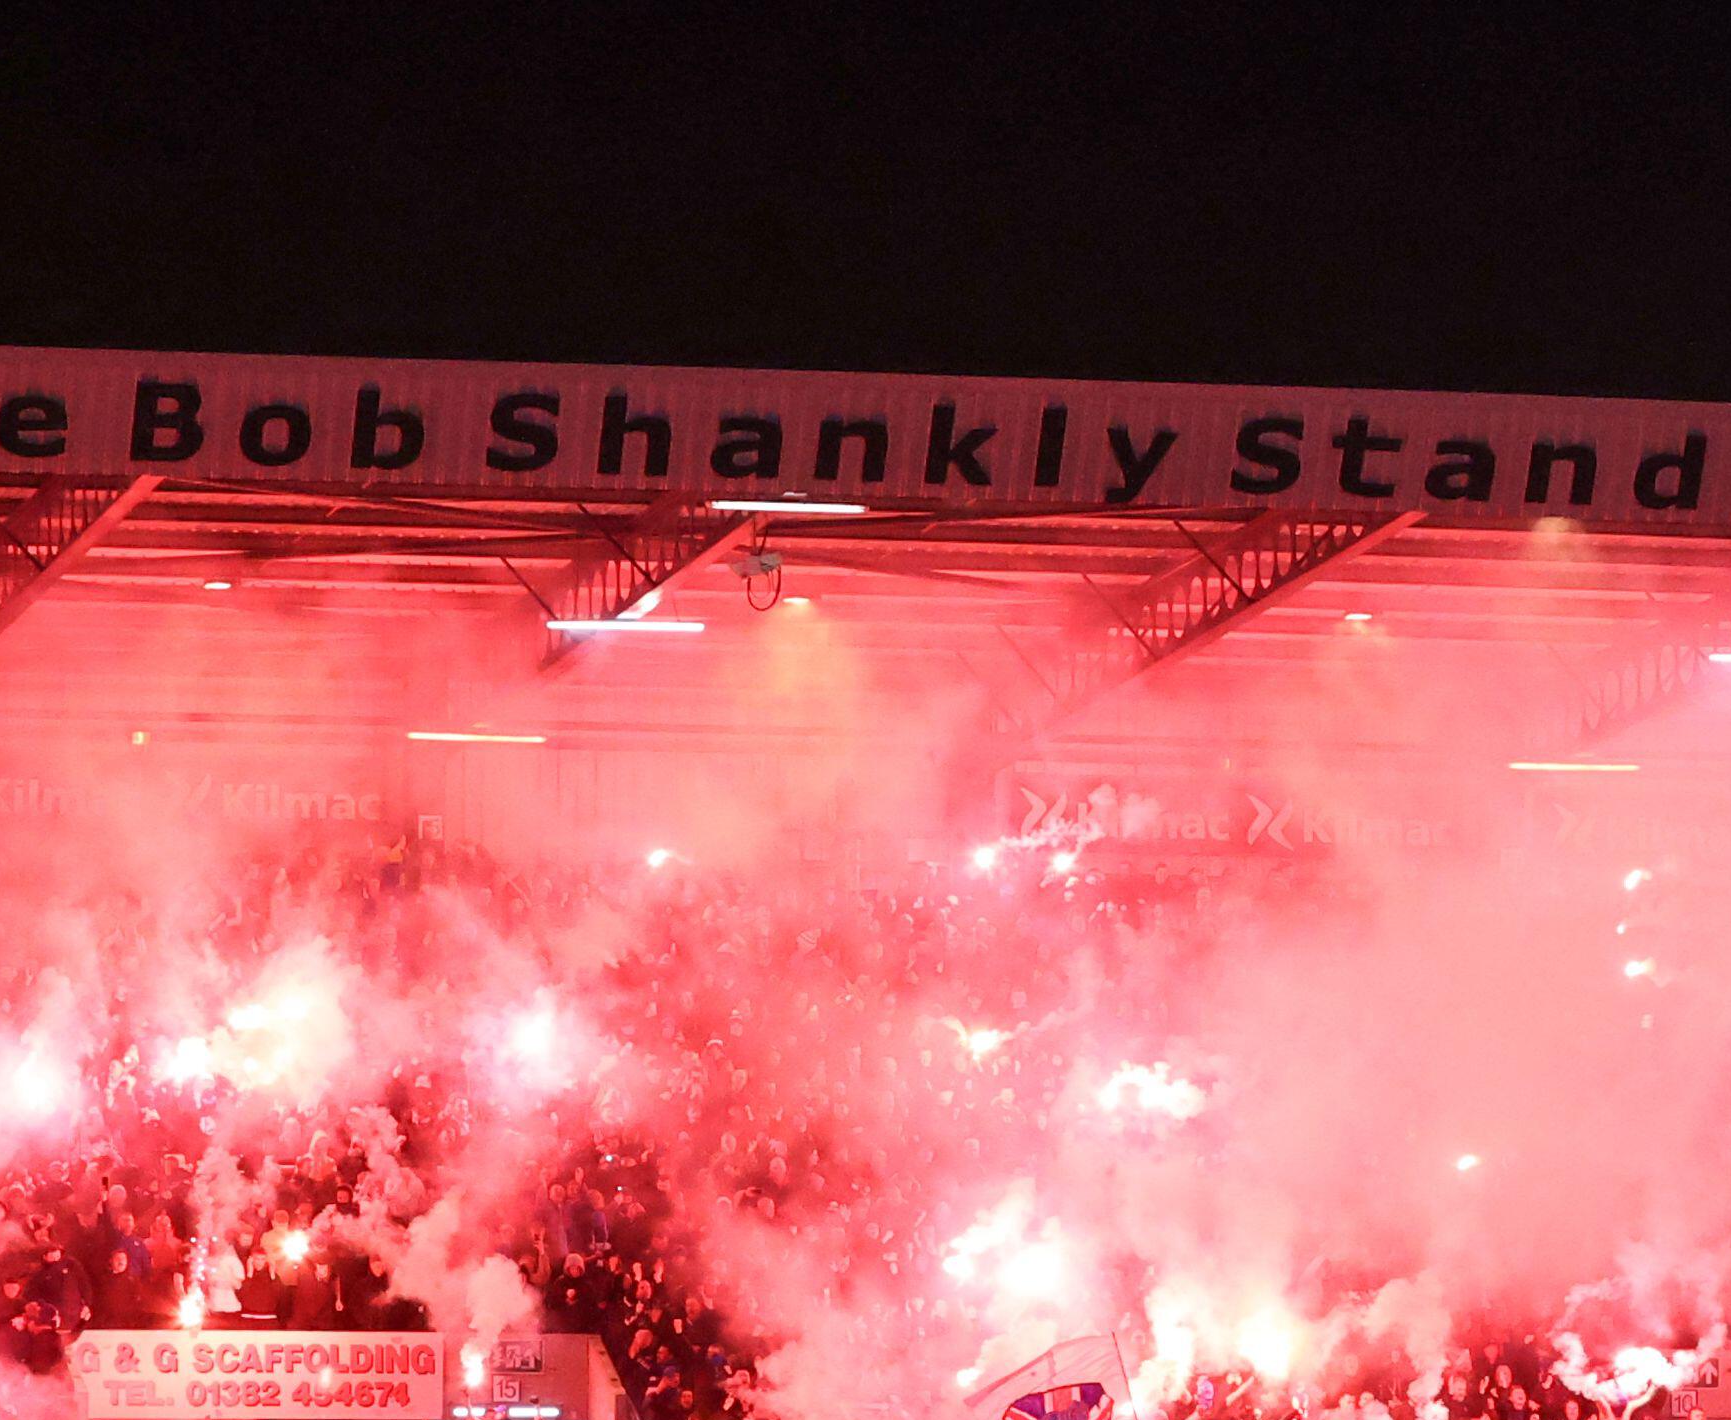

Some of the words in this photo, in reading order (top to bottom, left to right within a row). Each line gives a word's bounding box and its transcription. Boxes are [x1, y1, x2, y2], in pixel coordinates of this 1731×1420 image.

[128, 376, 427, 468] Bob
[484, 384, 1179, 503] Shankly
[1228, 413, 1707, 511] Stand
[76, 1342, 100, 1372] G
[114, 1342, 140, 1373] &
[153, 1343, 178, 1373] G
[193, 1343, 436, 1375] SCAFFOLDING
[103, 1380, 174, 1407] TEL.
[186, 1381, 281, 1408] 01382
[496, 1378, 517, 1399] 15
